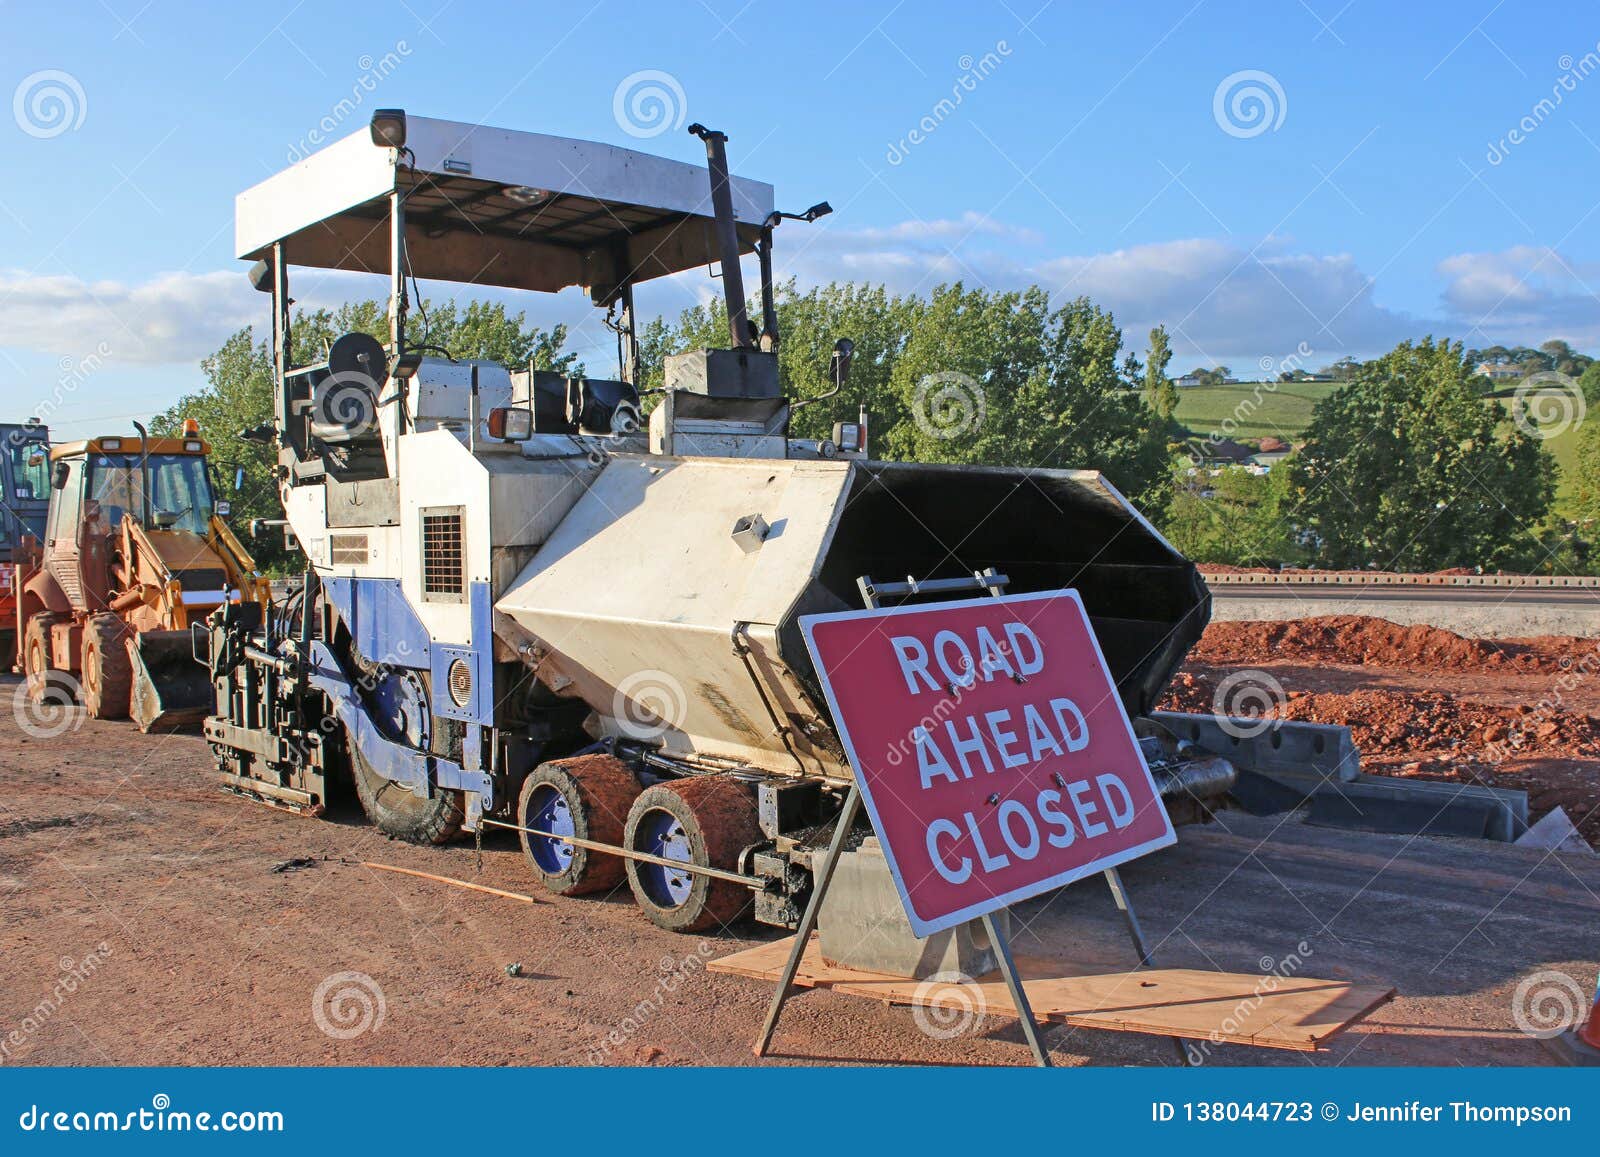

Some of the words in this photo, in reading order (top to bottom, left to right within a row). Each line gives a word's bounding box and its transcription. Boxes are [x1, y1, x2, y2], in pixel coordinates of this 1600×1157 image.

[891, 622, 1044, 695] ROAD
[913, 698, 1090, 789] AHEAD
[926, 773, 1135, 884] CLOSED
